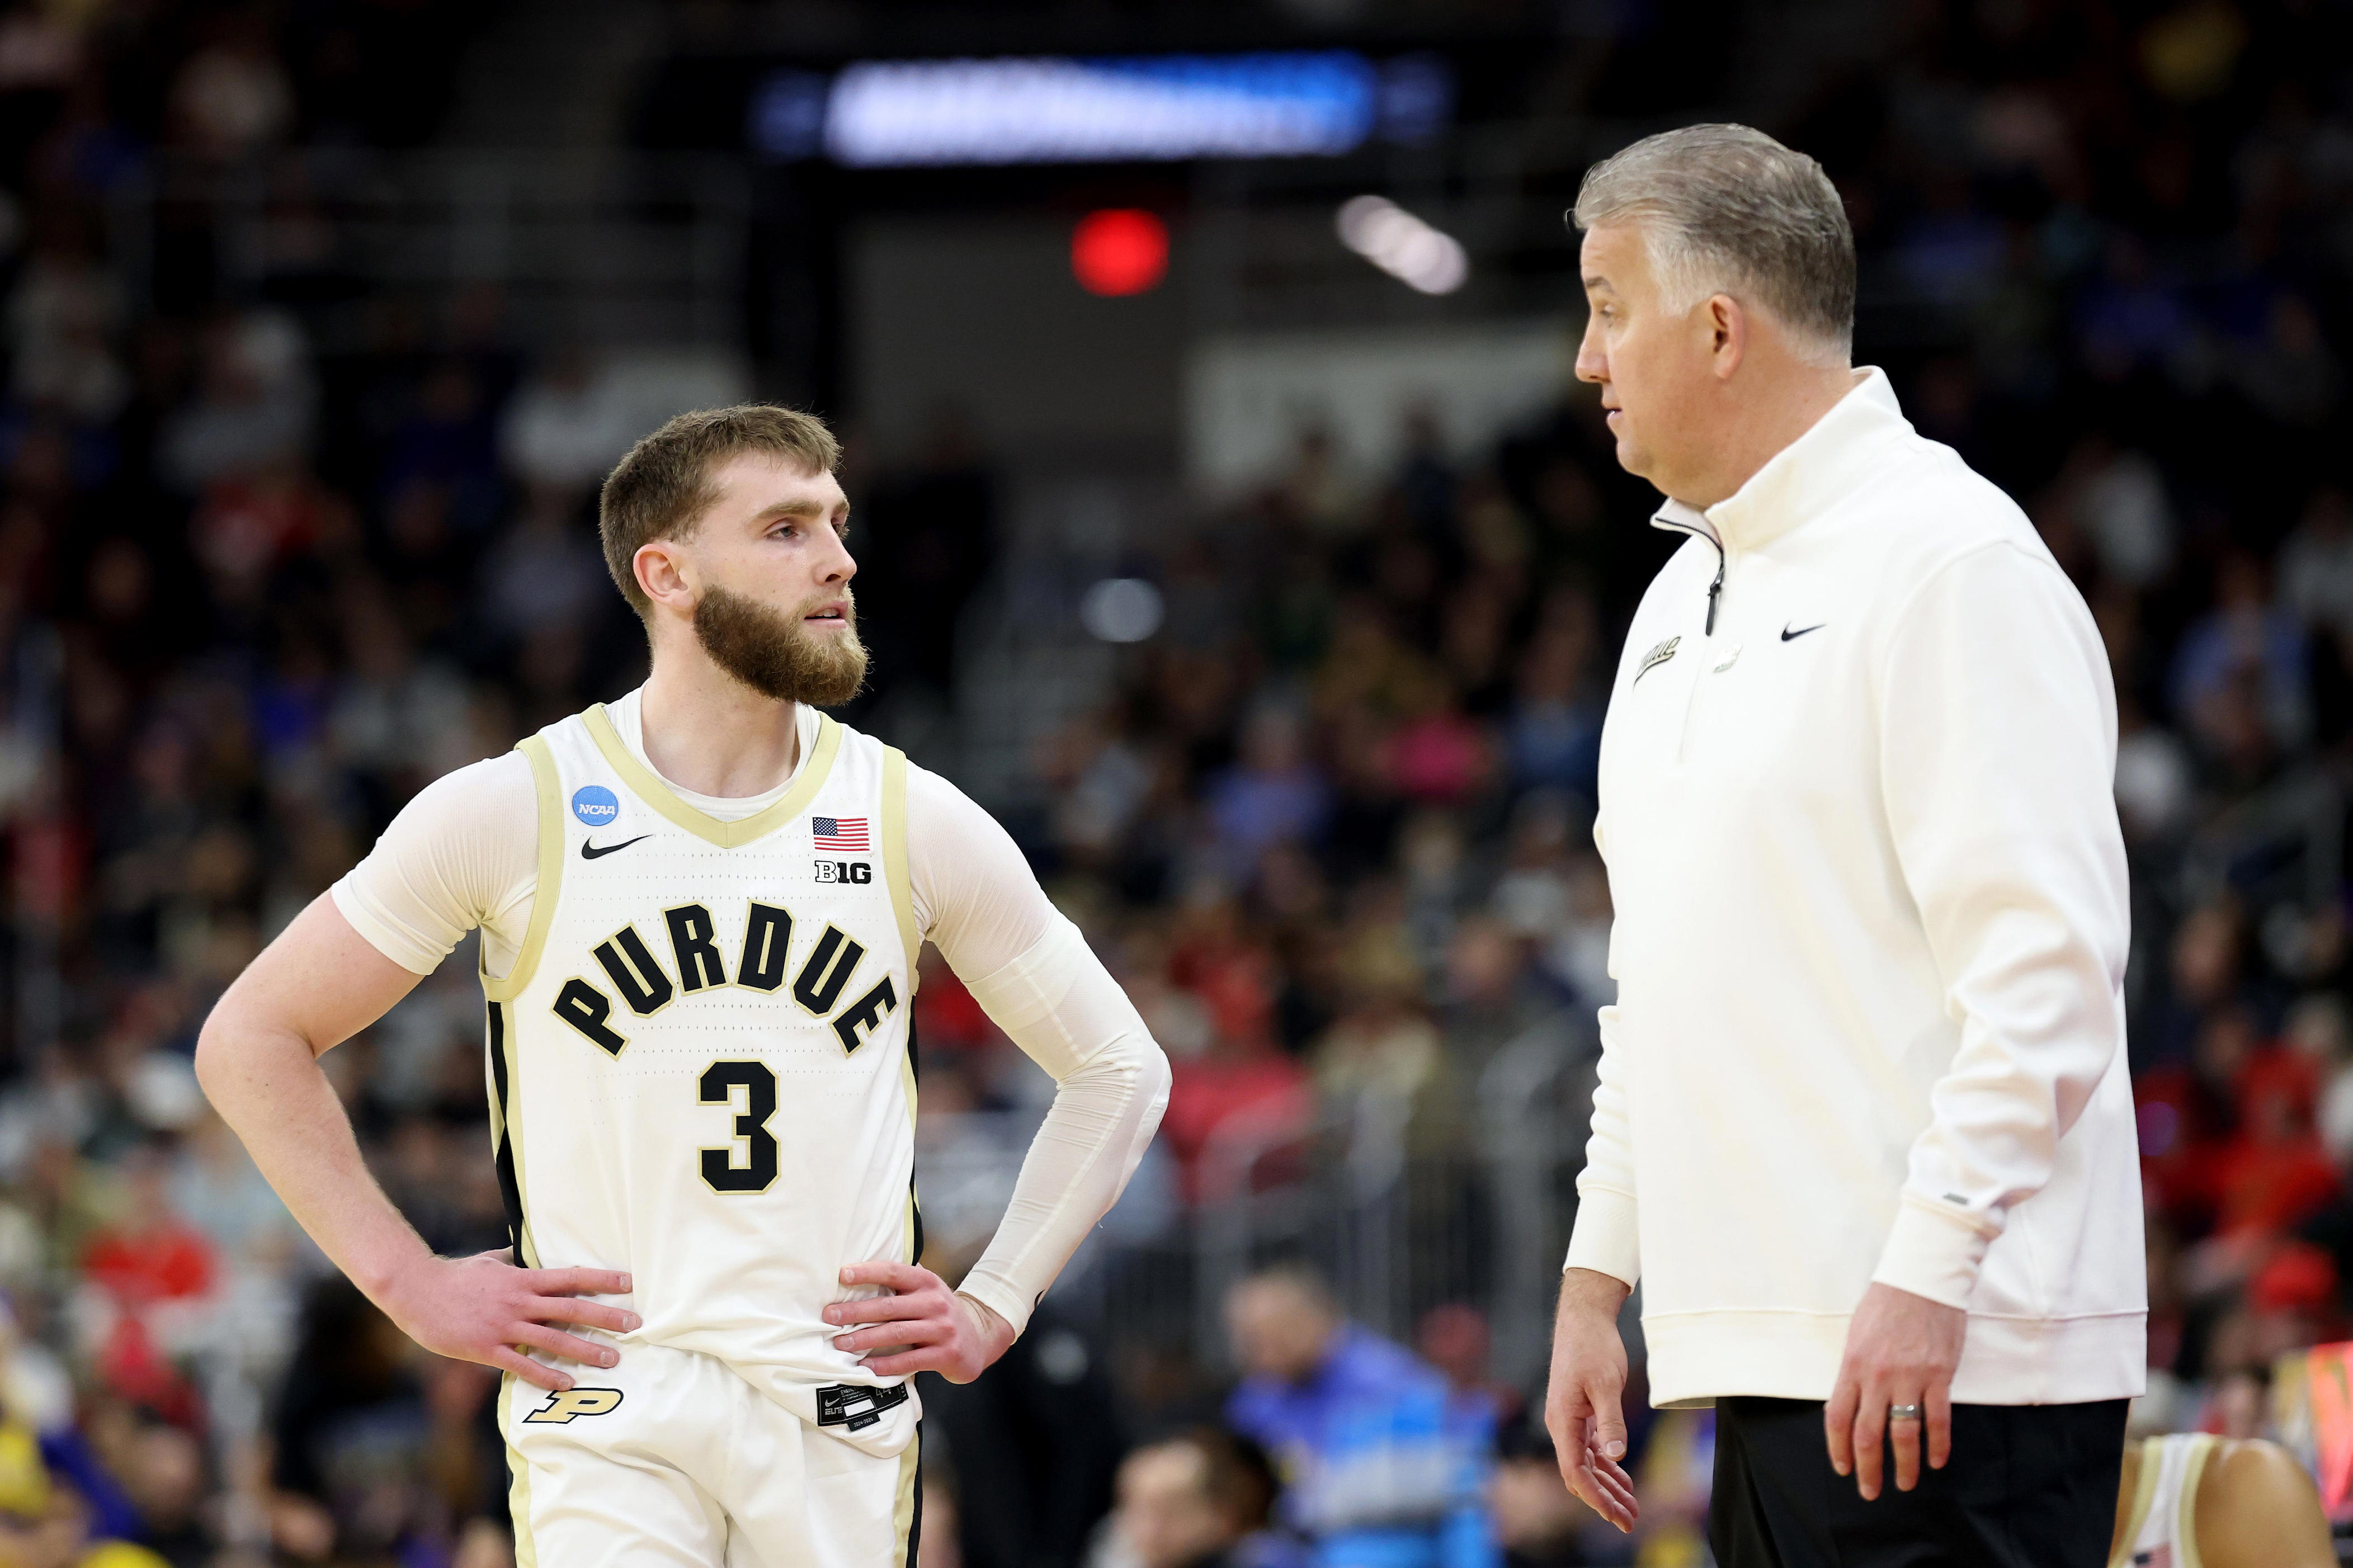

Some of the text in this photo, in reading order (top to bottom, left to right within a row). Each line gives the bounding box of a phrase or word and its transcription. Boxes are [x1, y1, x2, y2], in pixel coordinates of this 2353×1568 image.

[578, 804, 615, 815] NCAA
[550, 899, 897, 1061] PURDUE
[696, 1059, 781, 1195] 3
[522, 1387, 624, 1424] P
[824, 1406, 843, 1416] ELITE
[854, 1417, 874, 1427] 2024-2025
